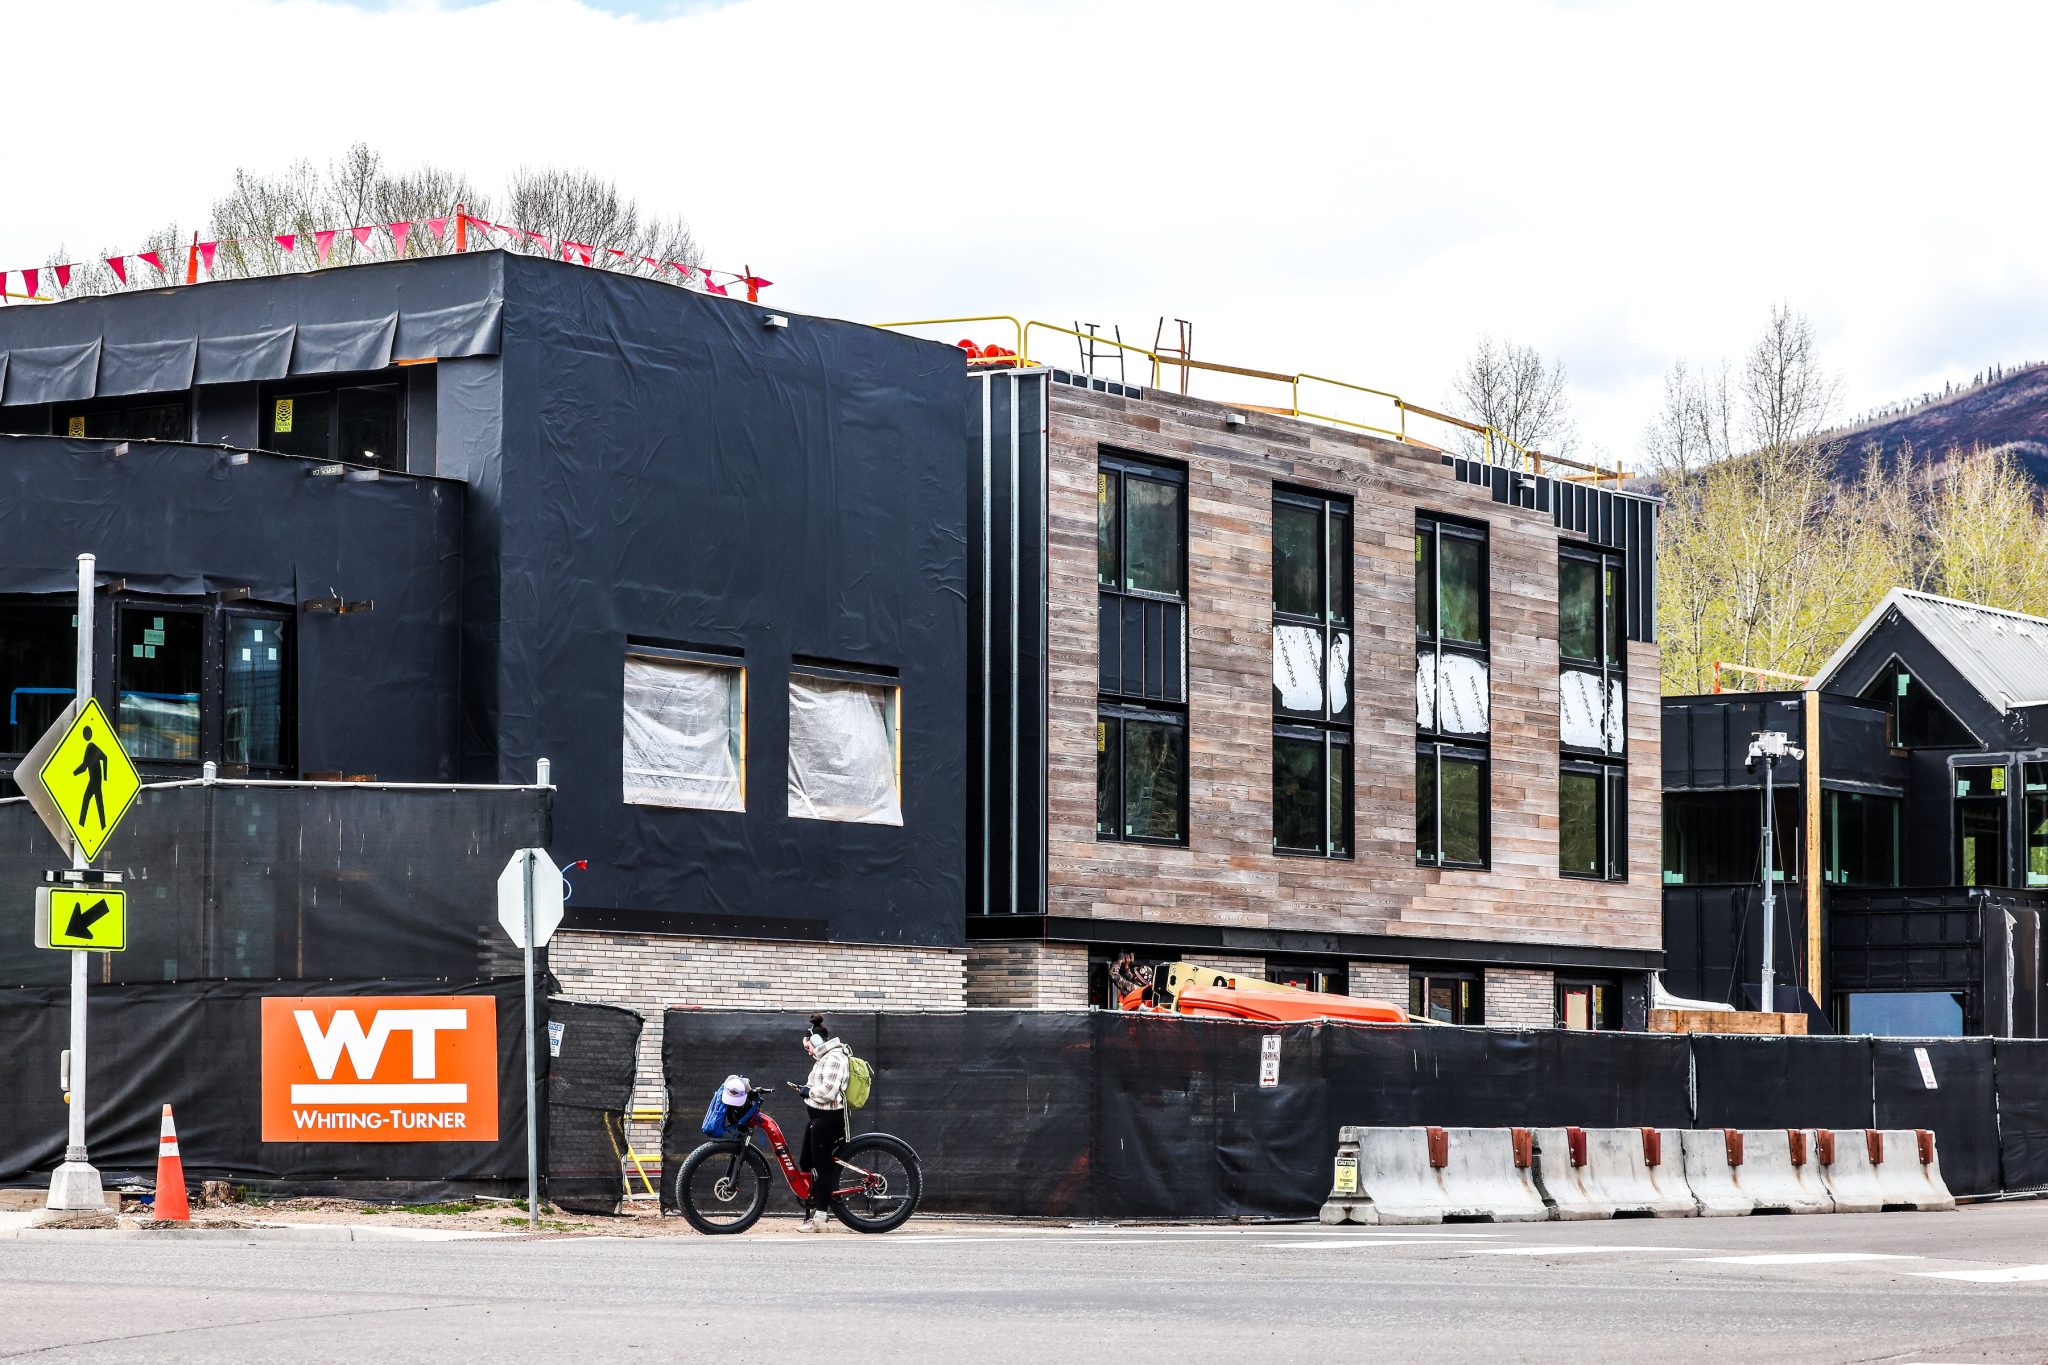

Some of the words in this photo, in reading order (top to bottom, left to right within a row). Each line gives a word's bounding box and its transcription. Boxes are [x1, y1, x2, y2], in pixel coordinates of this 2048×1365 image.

[293, 1008, 467, 1080] WT
[1267, 1040, 1276, 1050] NO
[1263, 1052, 1279, 1061] PARKING
